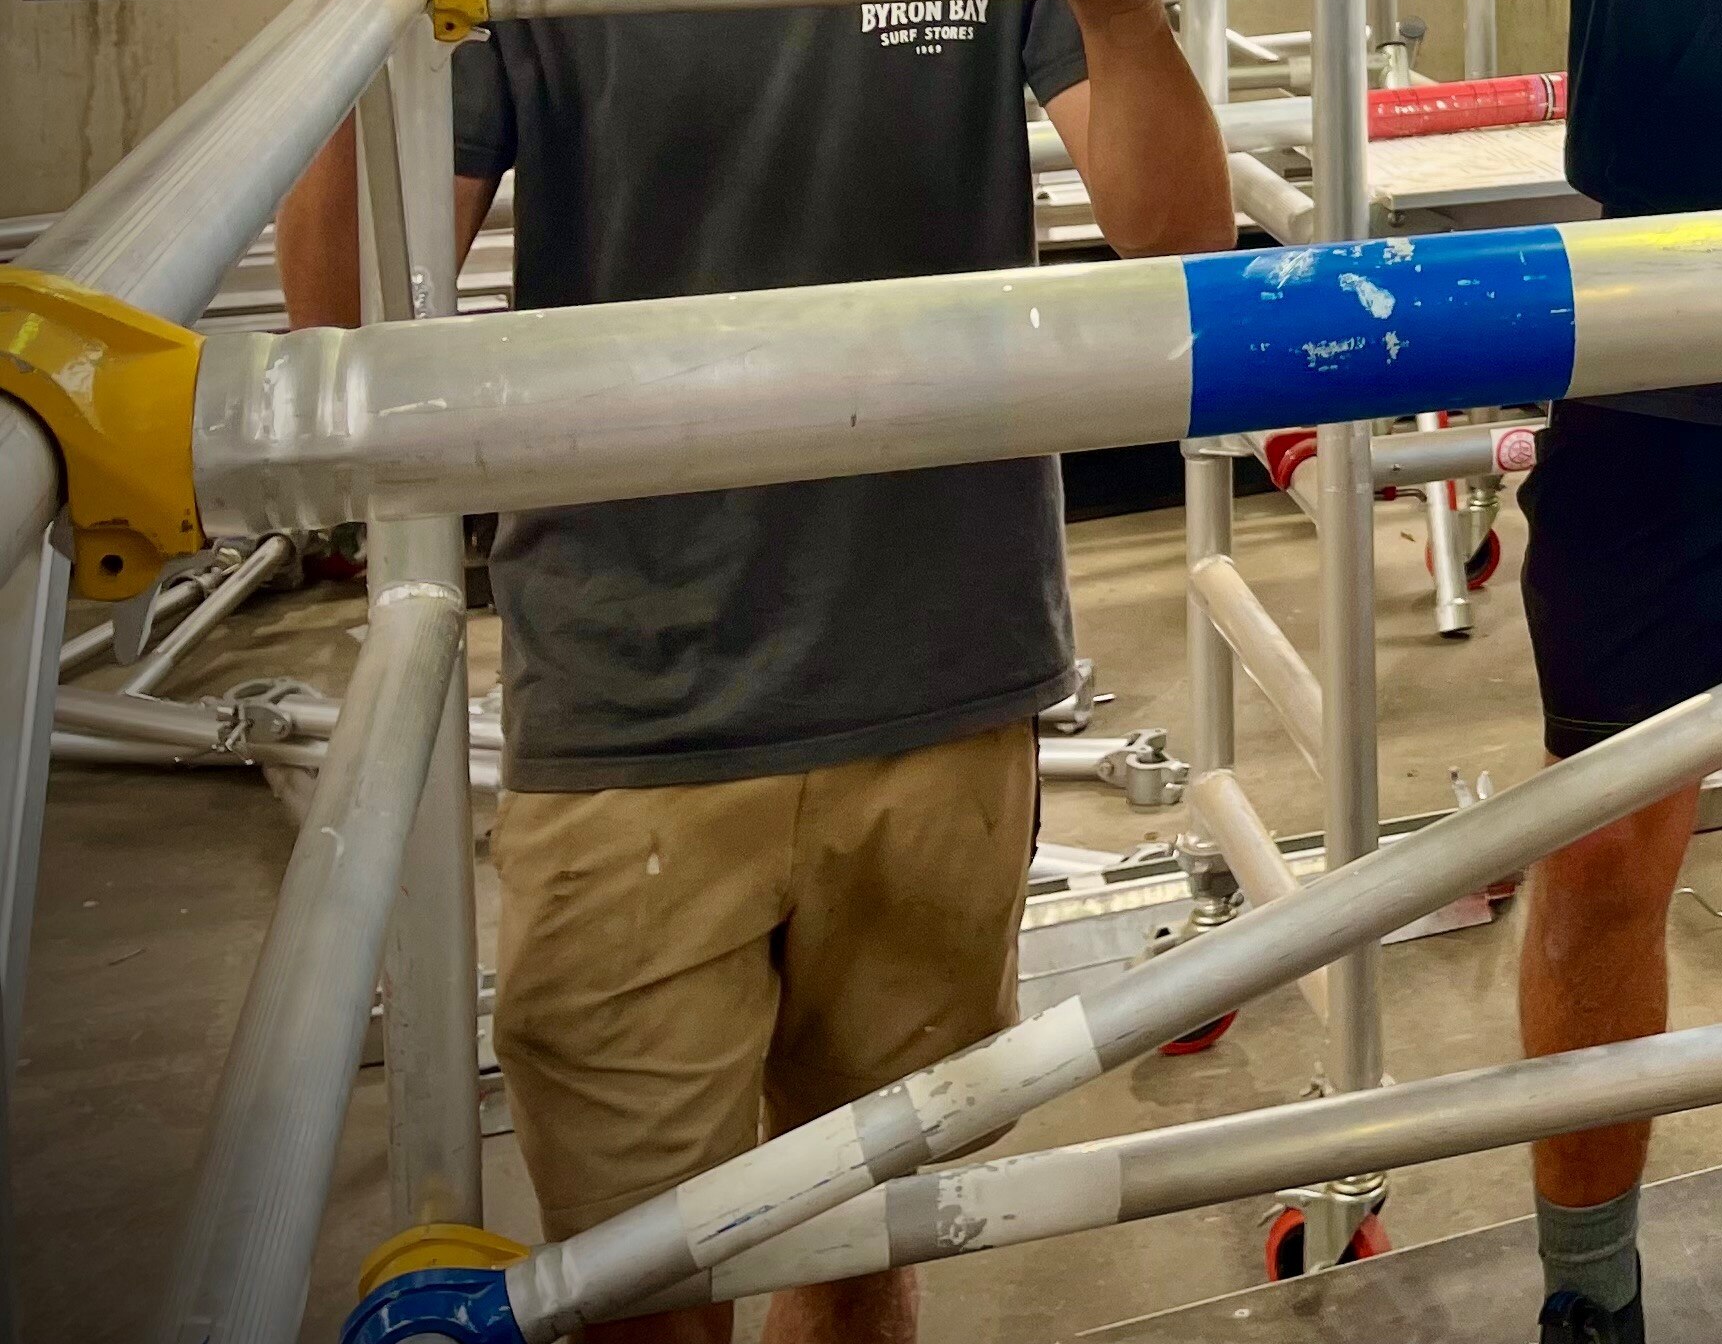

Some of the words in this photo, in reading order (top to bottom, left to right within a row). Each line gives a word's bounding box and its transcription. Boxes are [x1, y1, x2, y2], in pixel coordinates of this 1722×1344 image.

[861, 0, 943, 32] BYRON
[880, 28, 917, 47] SURF
[924, 26, 974, 41] STORES
